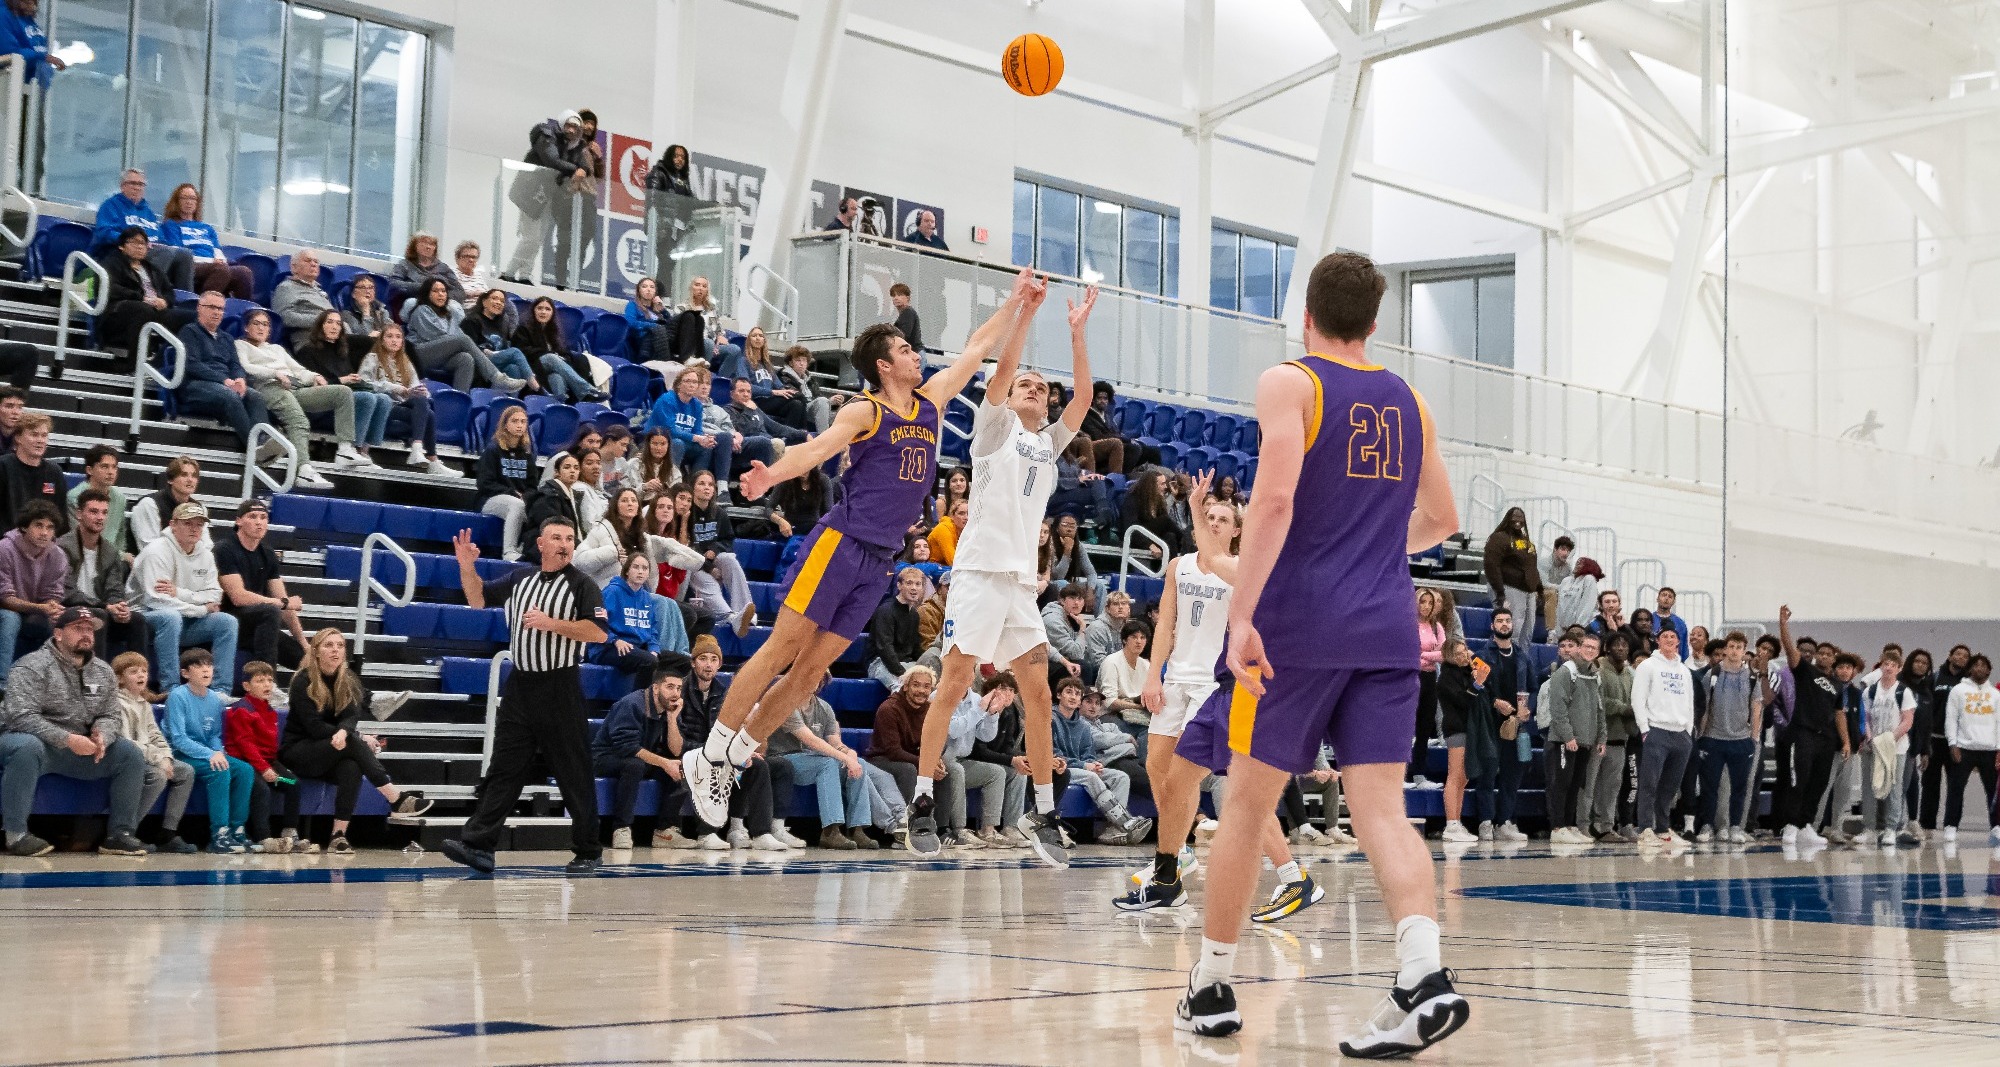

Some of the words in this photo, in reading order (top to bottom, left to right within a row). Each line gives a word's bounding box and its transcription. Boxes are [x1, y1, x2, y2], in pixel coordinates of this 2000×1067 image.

[889, 425, 936, 446] EMERSON
[1346, 403, 1403, 481] 21
[899, 446, 927, 482] 10
[1023, 466, 1037, 496] 1
[1178, 582, 1227, 600] COLBY
[1190, 600, 1205, 627] 0
[944, 619, 954, 638] C
